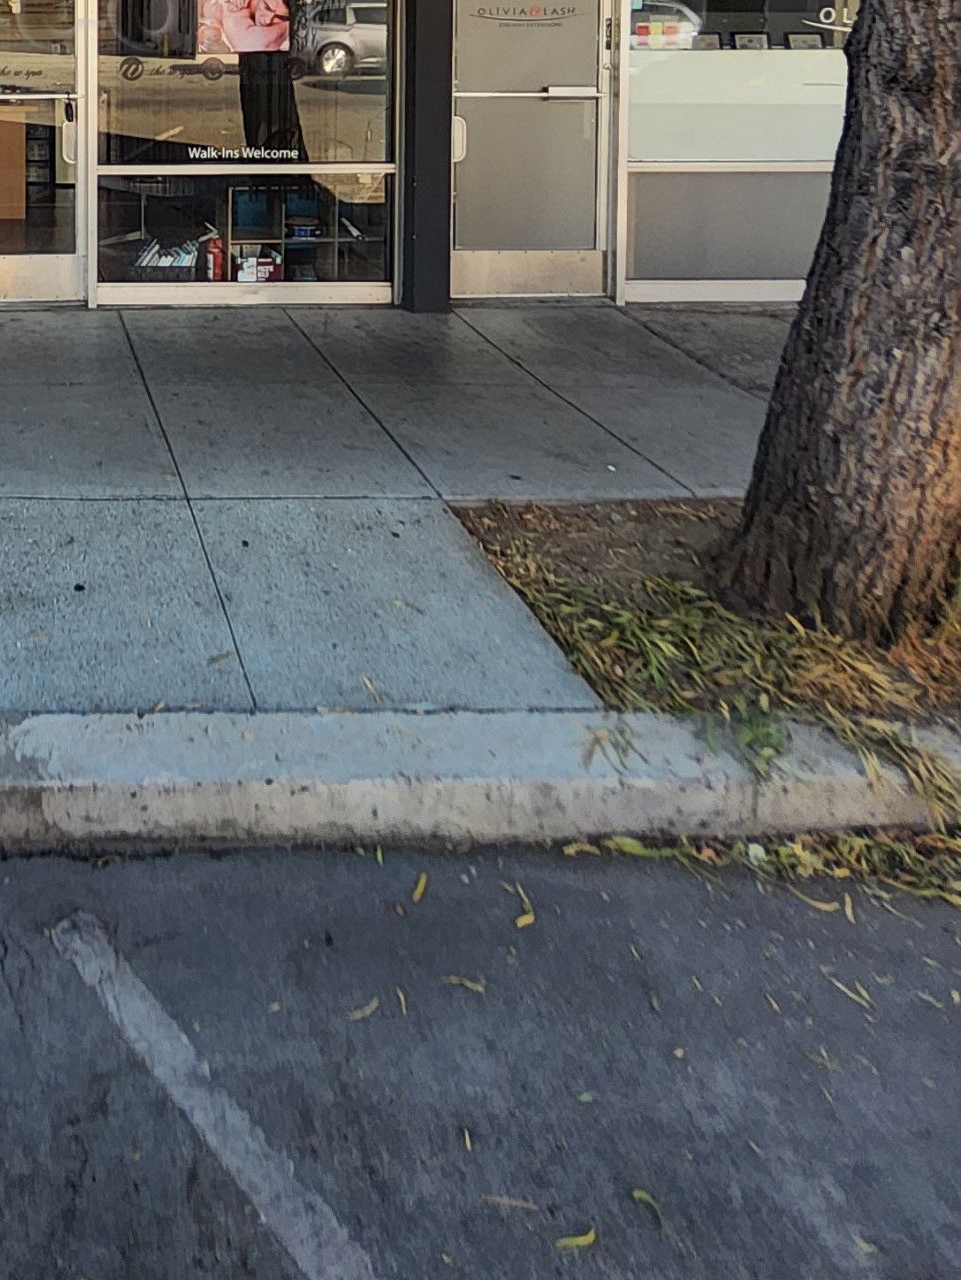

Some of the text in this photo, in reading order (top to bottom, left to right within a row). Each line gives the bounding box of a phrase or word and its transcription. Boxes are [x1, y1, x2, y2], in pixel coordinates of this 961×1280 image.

[477, 6, 576, 17] OLIVIA LASH
[188, 146, 299, 159] Walk-Ins Welcome
